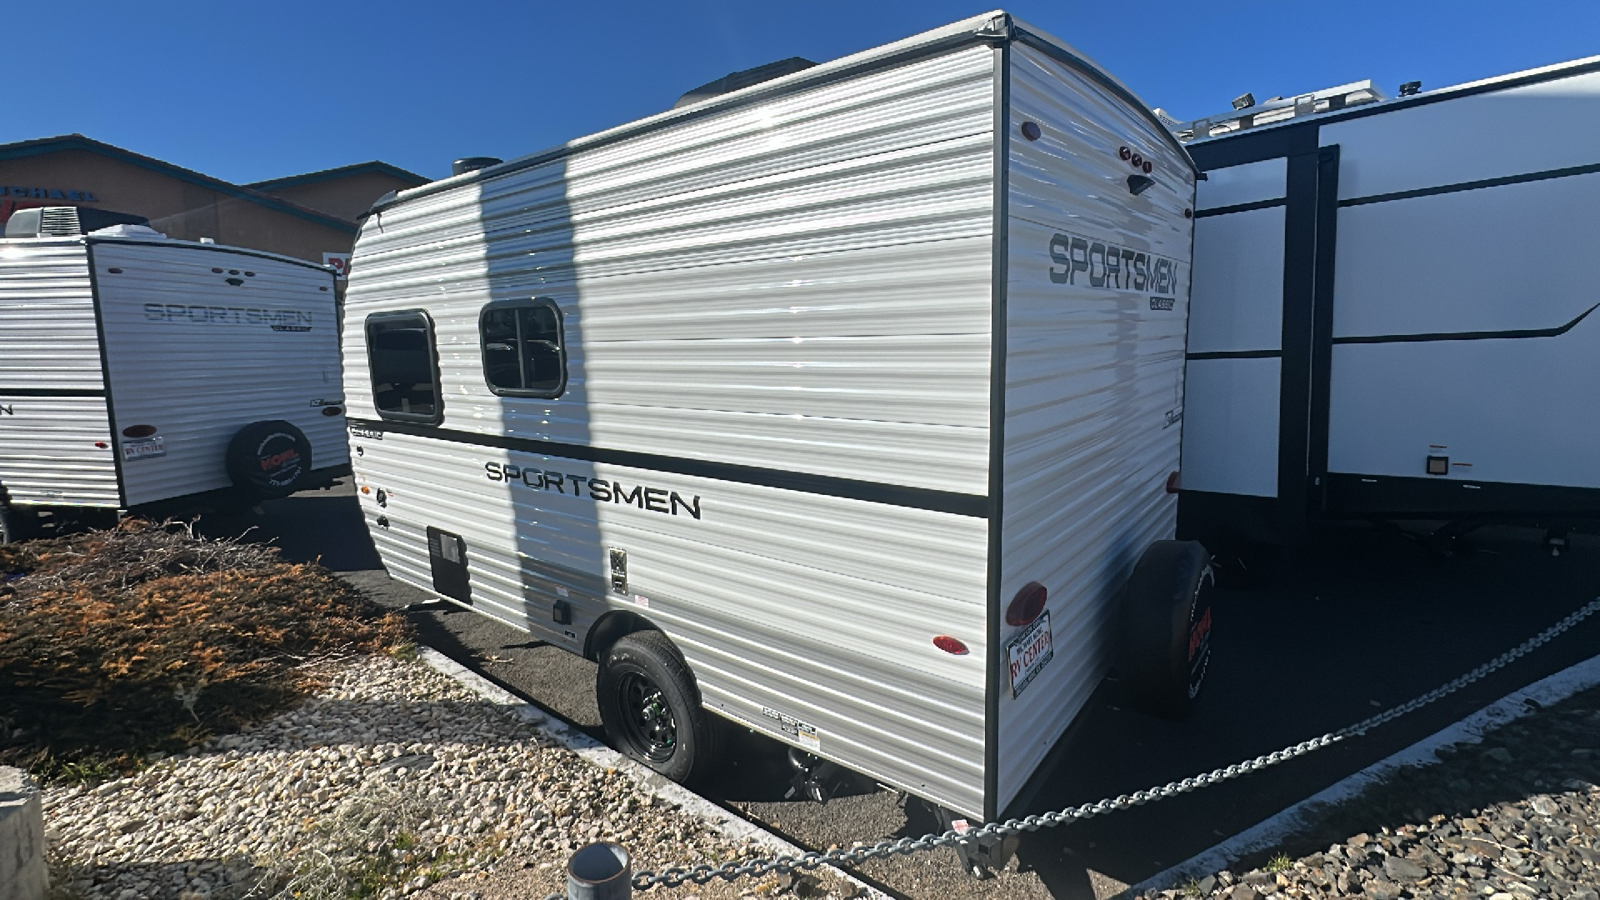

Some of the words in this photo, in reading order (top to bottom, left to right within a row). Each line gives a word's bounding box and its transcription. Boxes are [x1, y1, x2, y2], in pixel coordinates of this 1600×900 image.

[1050, 233, 1177, 294] SPORTSMEN
[144, 303, 312, 325] SPORTSMEN
[485, 462, 701, 520] SPORTSMEN
[1010, 656, 1022, 678] RV
[1023, 631, 1049, 668] CENTER
